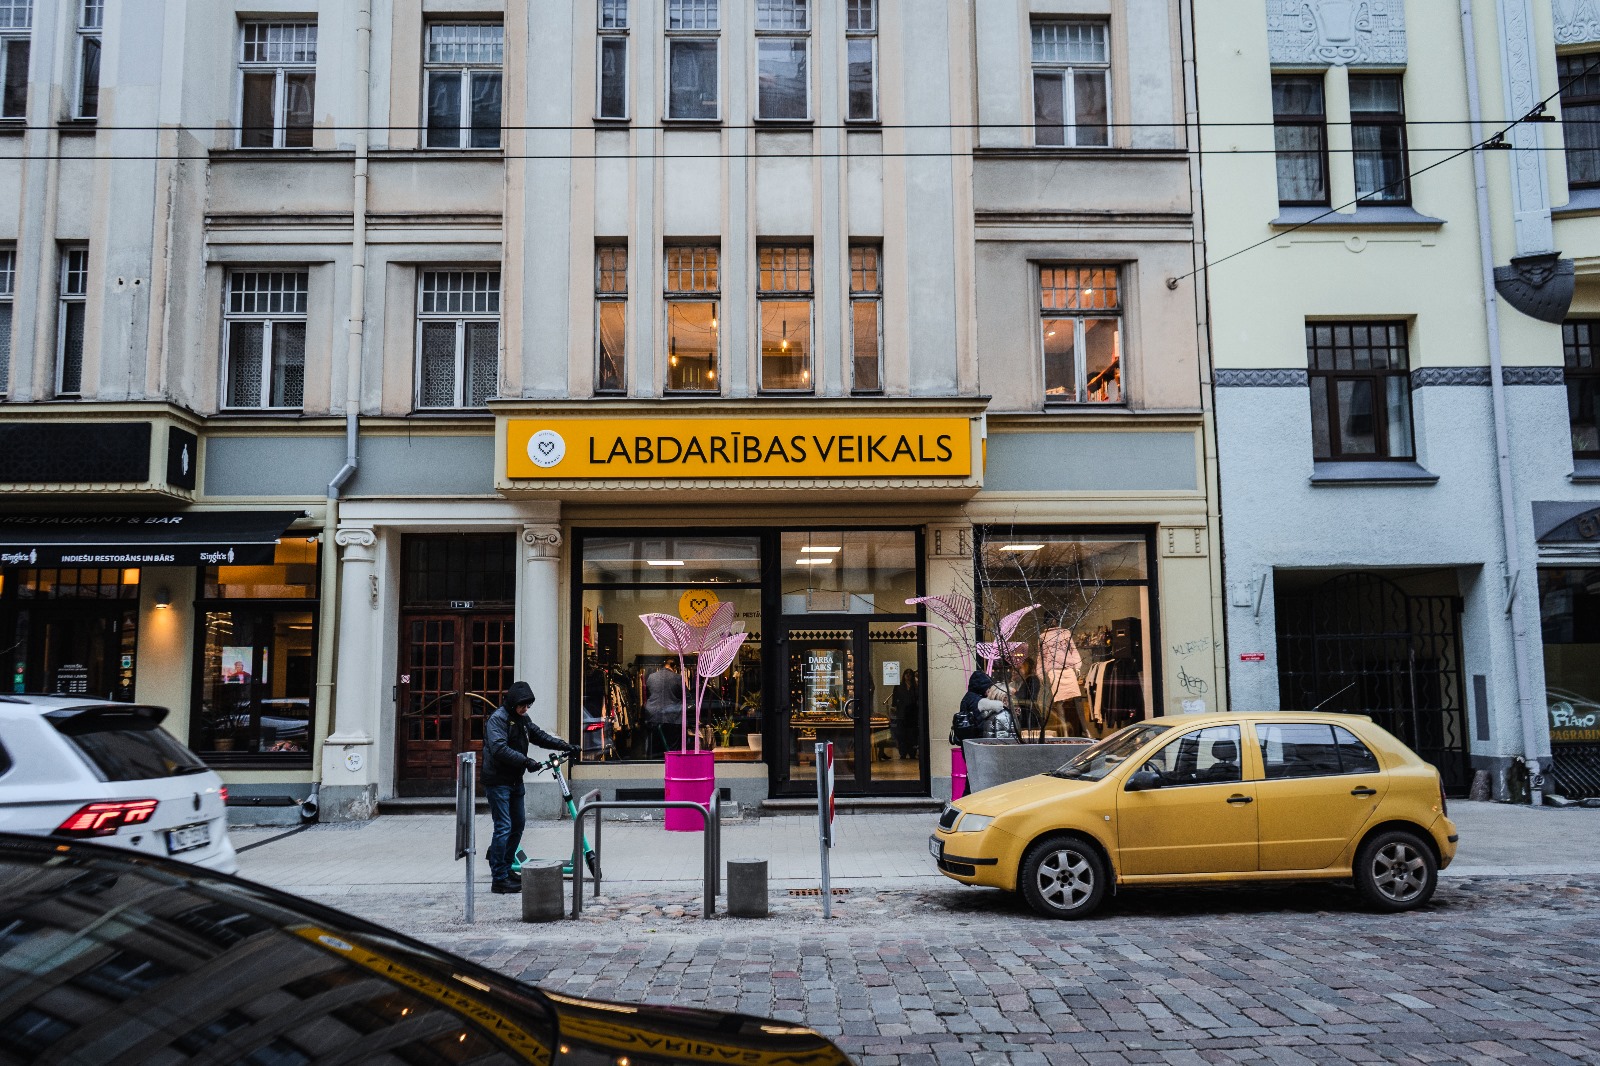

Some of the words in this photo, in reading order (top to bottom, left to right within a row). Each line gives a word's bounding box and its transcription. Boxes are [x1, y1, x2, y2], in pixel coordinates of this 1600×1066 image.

[589, 431, 807, 465] LABDARĪBAS
[812, 434, 953, 464] VEIKALS
[144, 516, 184, 524] BAR
[61, 554, 94, 562] INDIEŠU
[95, 554, 142, 562] RESTORĀNS
[154, 554, 175, 562] BĀRS
[808, 656, 834, 664] DARBA
[810, 663, 832, 671] LAIKS
